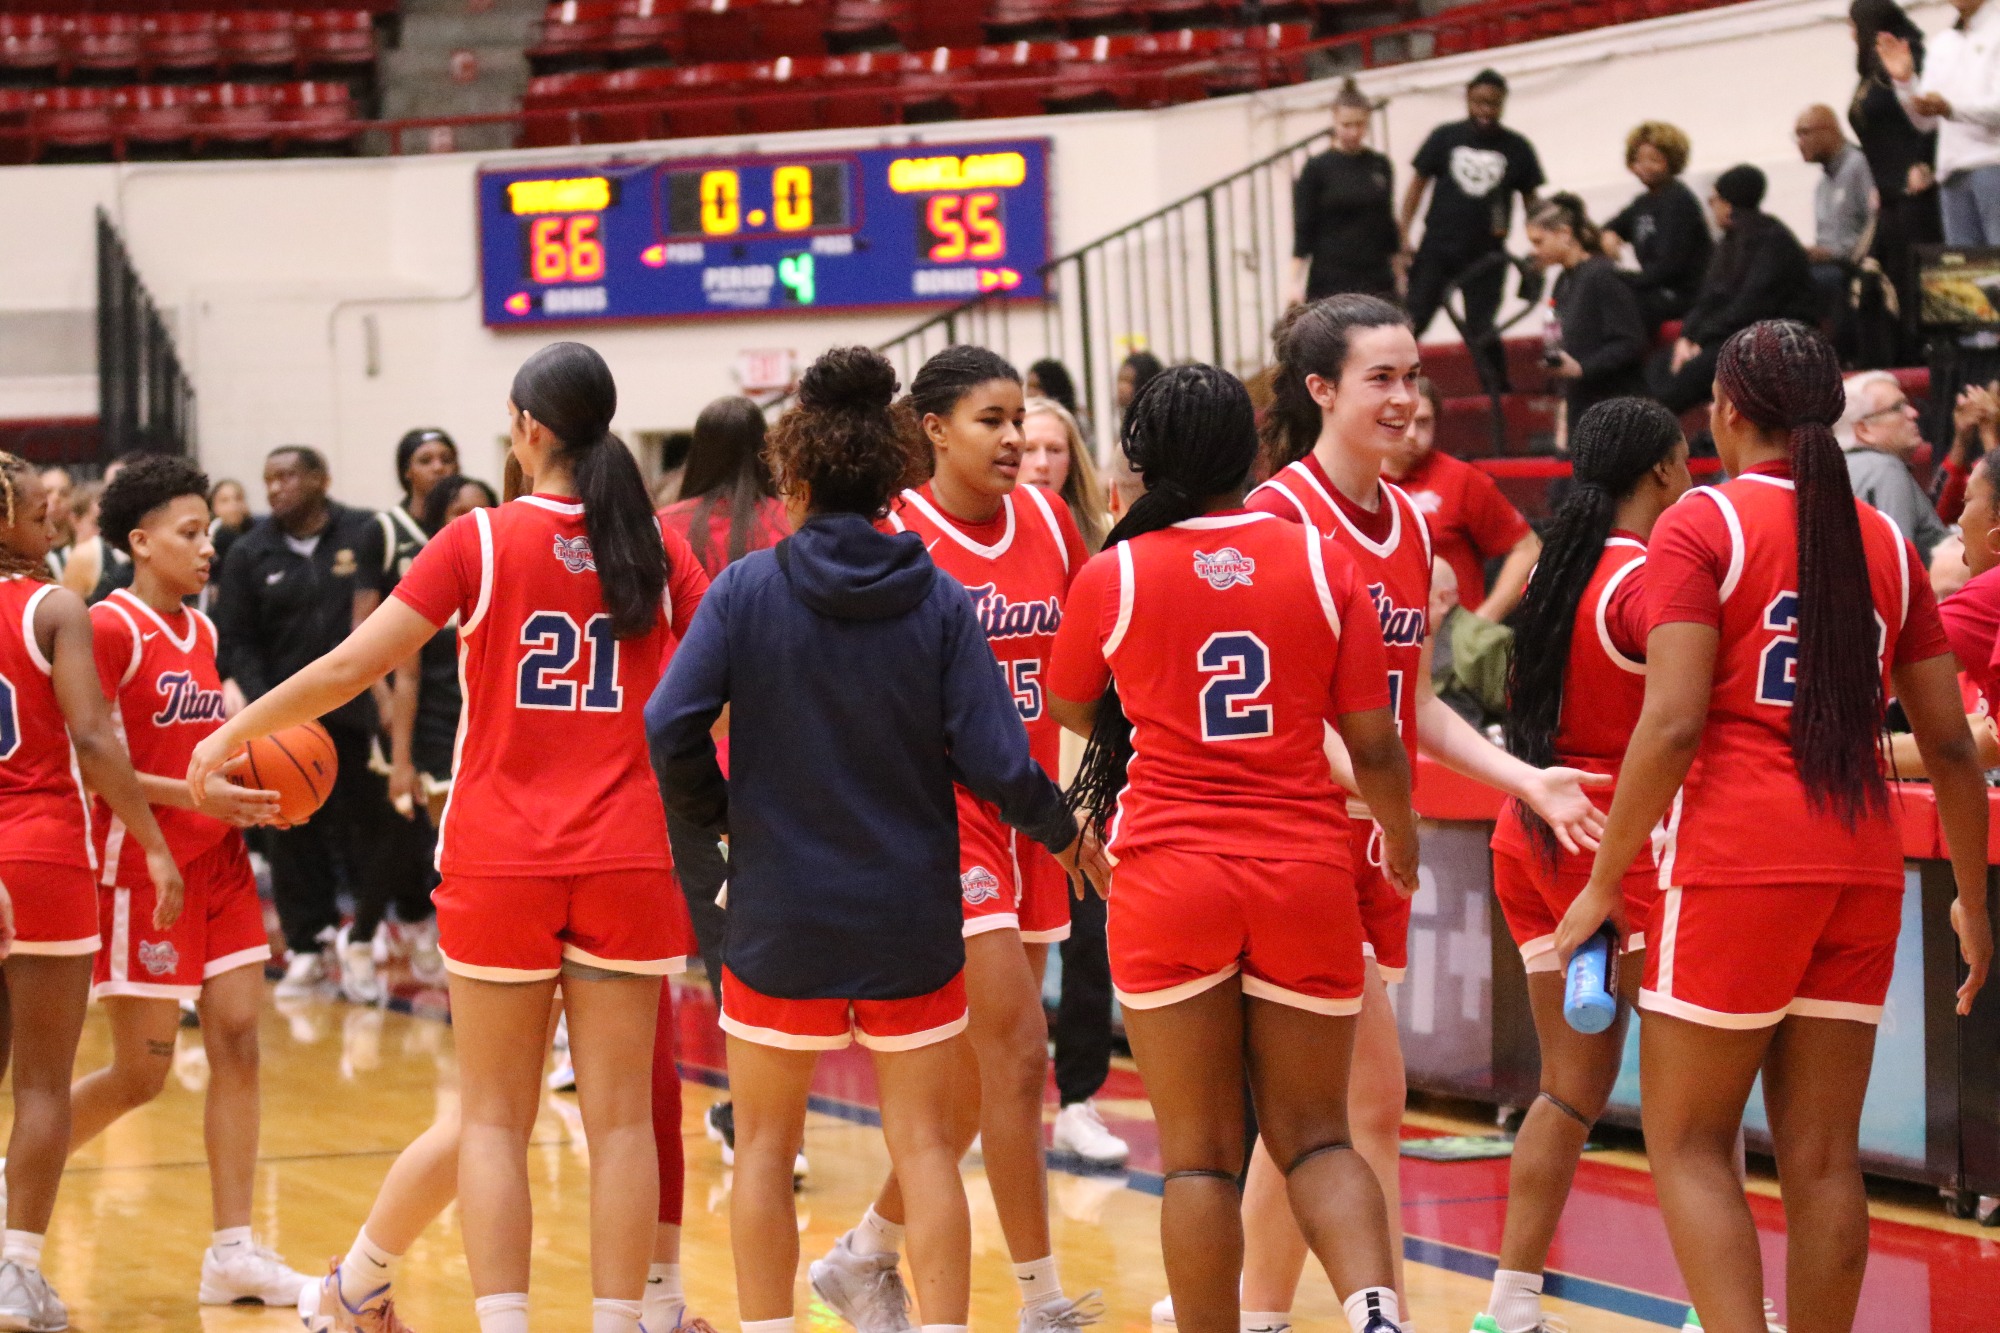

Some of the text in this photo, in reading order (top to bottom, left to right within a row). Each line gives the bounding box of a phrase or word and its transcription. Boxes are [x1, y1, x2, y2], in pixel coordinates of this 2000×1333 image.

[701, 166, 813, 236] 0.0
[926, 192, 1006, 264] 55
[530, 214, 606, 284] 66
[702, 264, 775, 292] PERIOD
[778, 253, 815, 304] 4
[555, 544, 594, 560] TITAN
[1197, 559, 1253, 578] TITANS
[516, 610, 623, 713] 21
[1197, 630, 1274, 742] 2
[152, 669, 226, 728] Titan
[962, 876, 998, 892] ITANS
